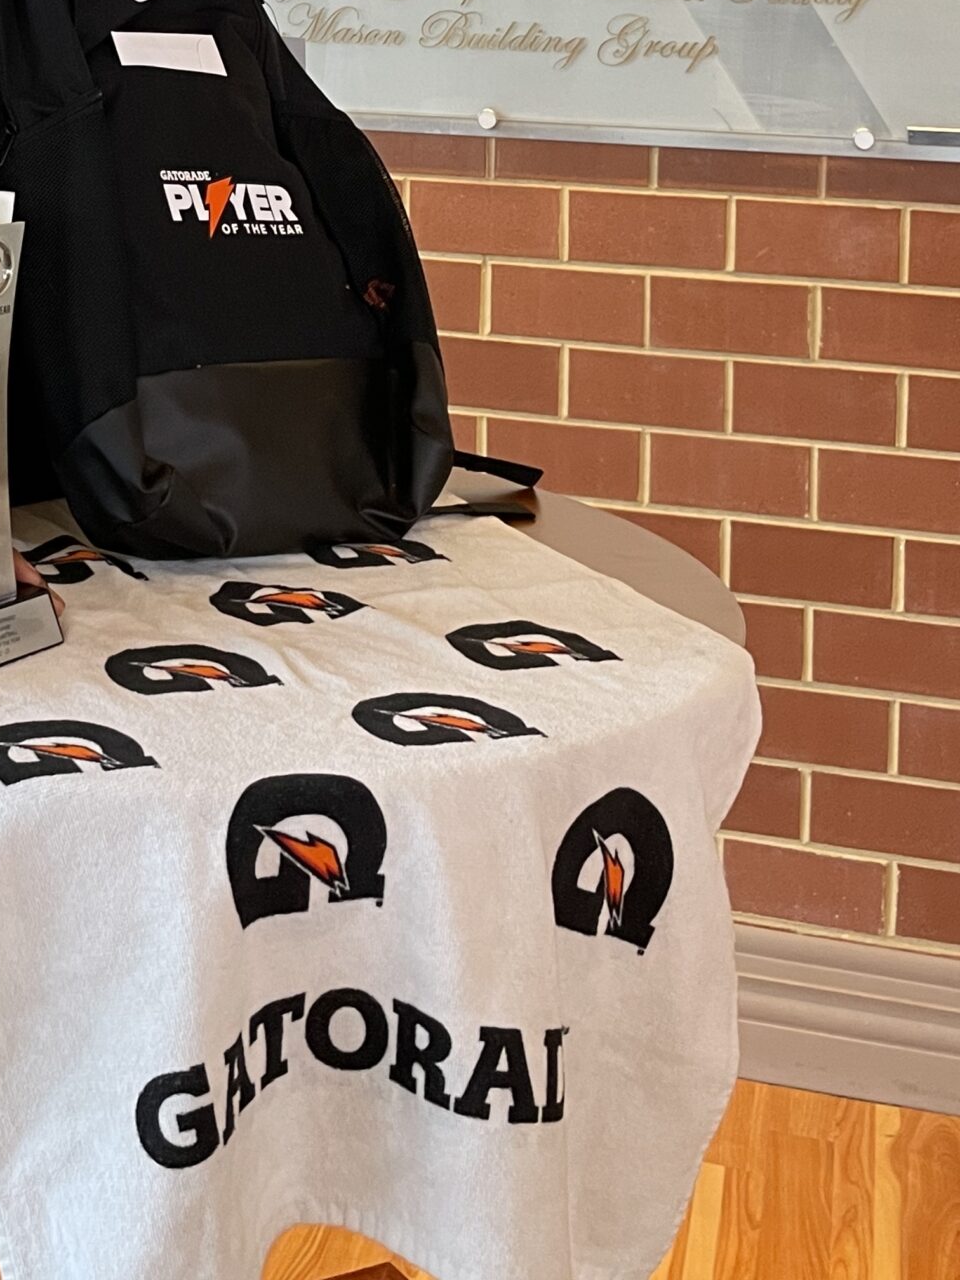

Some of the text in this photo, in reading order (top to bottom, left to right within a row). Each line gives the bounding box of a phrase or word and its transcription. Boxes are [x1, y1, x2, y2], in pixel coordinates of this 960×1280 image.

[282, 2, 719, 73] Mason Building Group
[160, 170, 211, 181] GATORADE
[222, 224, 303, 235] OF THE YEAR
